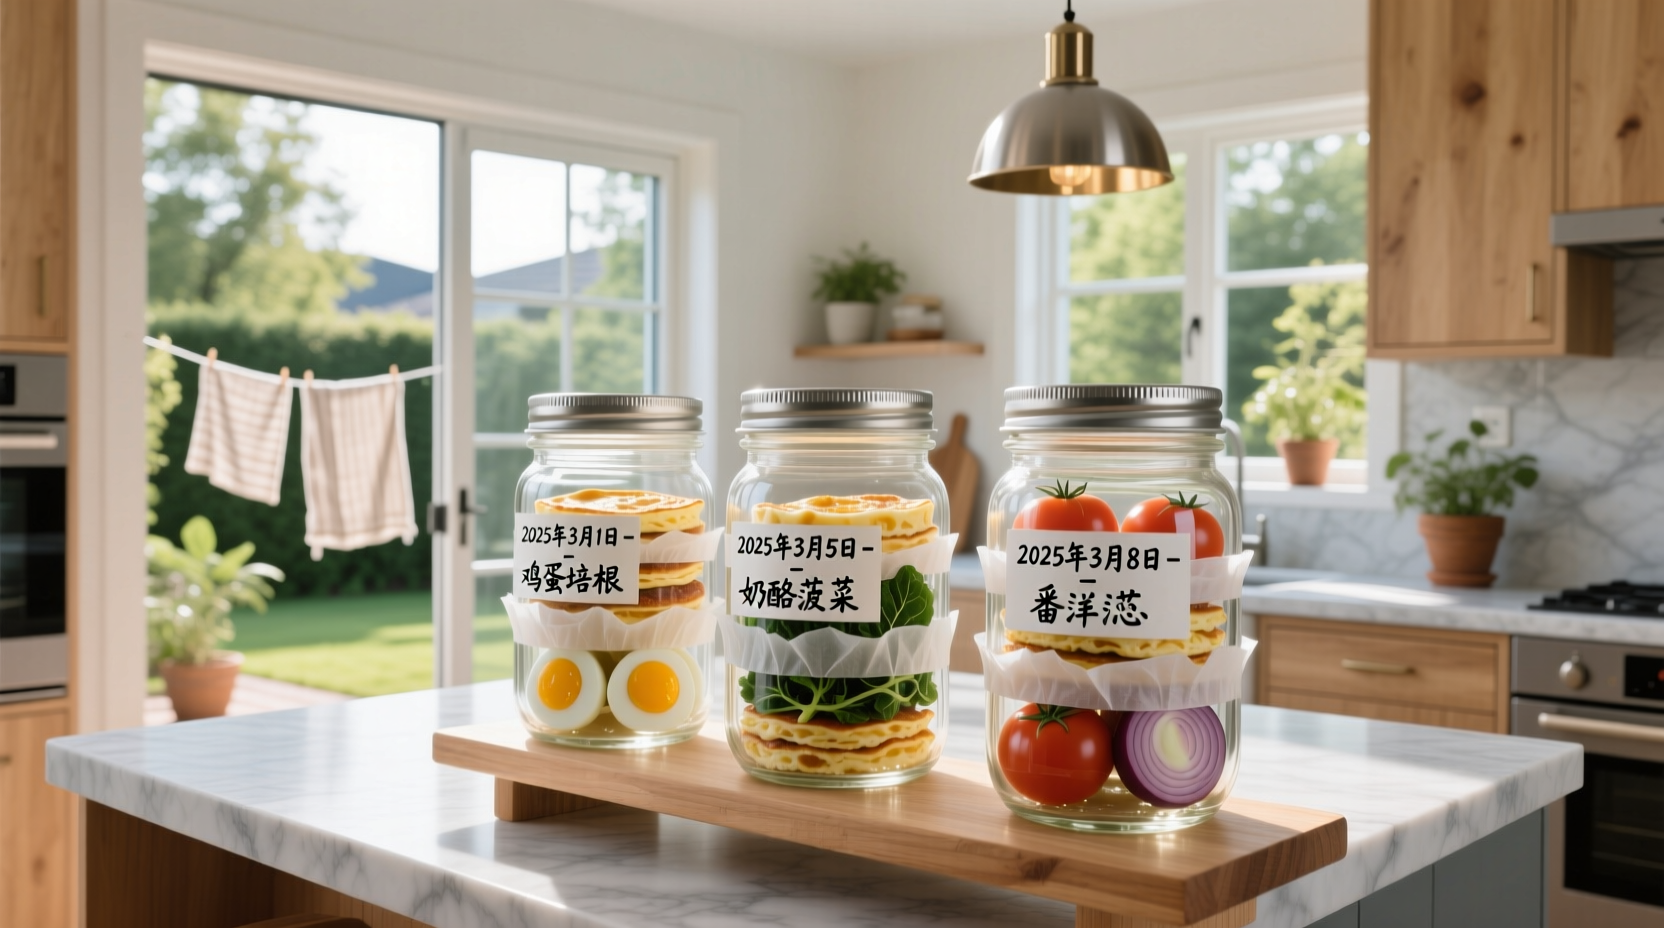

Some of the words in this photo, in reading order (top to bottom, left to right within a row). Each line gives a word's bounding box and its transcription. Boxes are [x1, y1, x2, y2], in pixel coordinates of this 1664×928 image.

[521, 560, 624, 595] 鸡蛋培根
[738, 575, 860, 614] 奶酪菠菜
